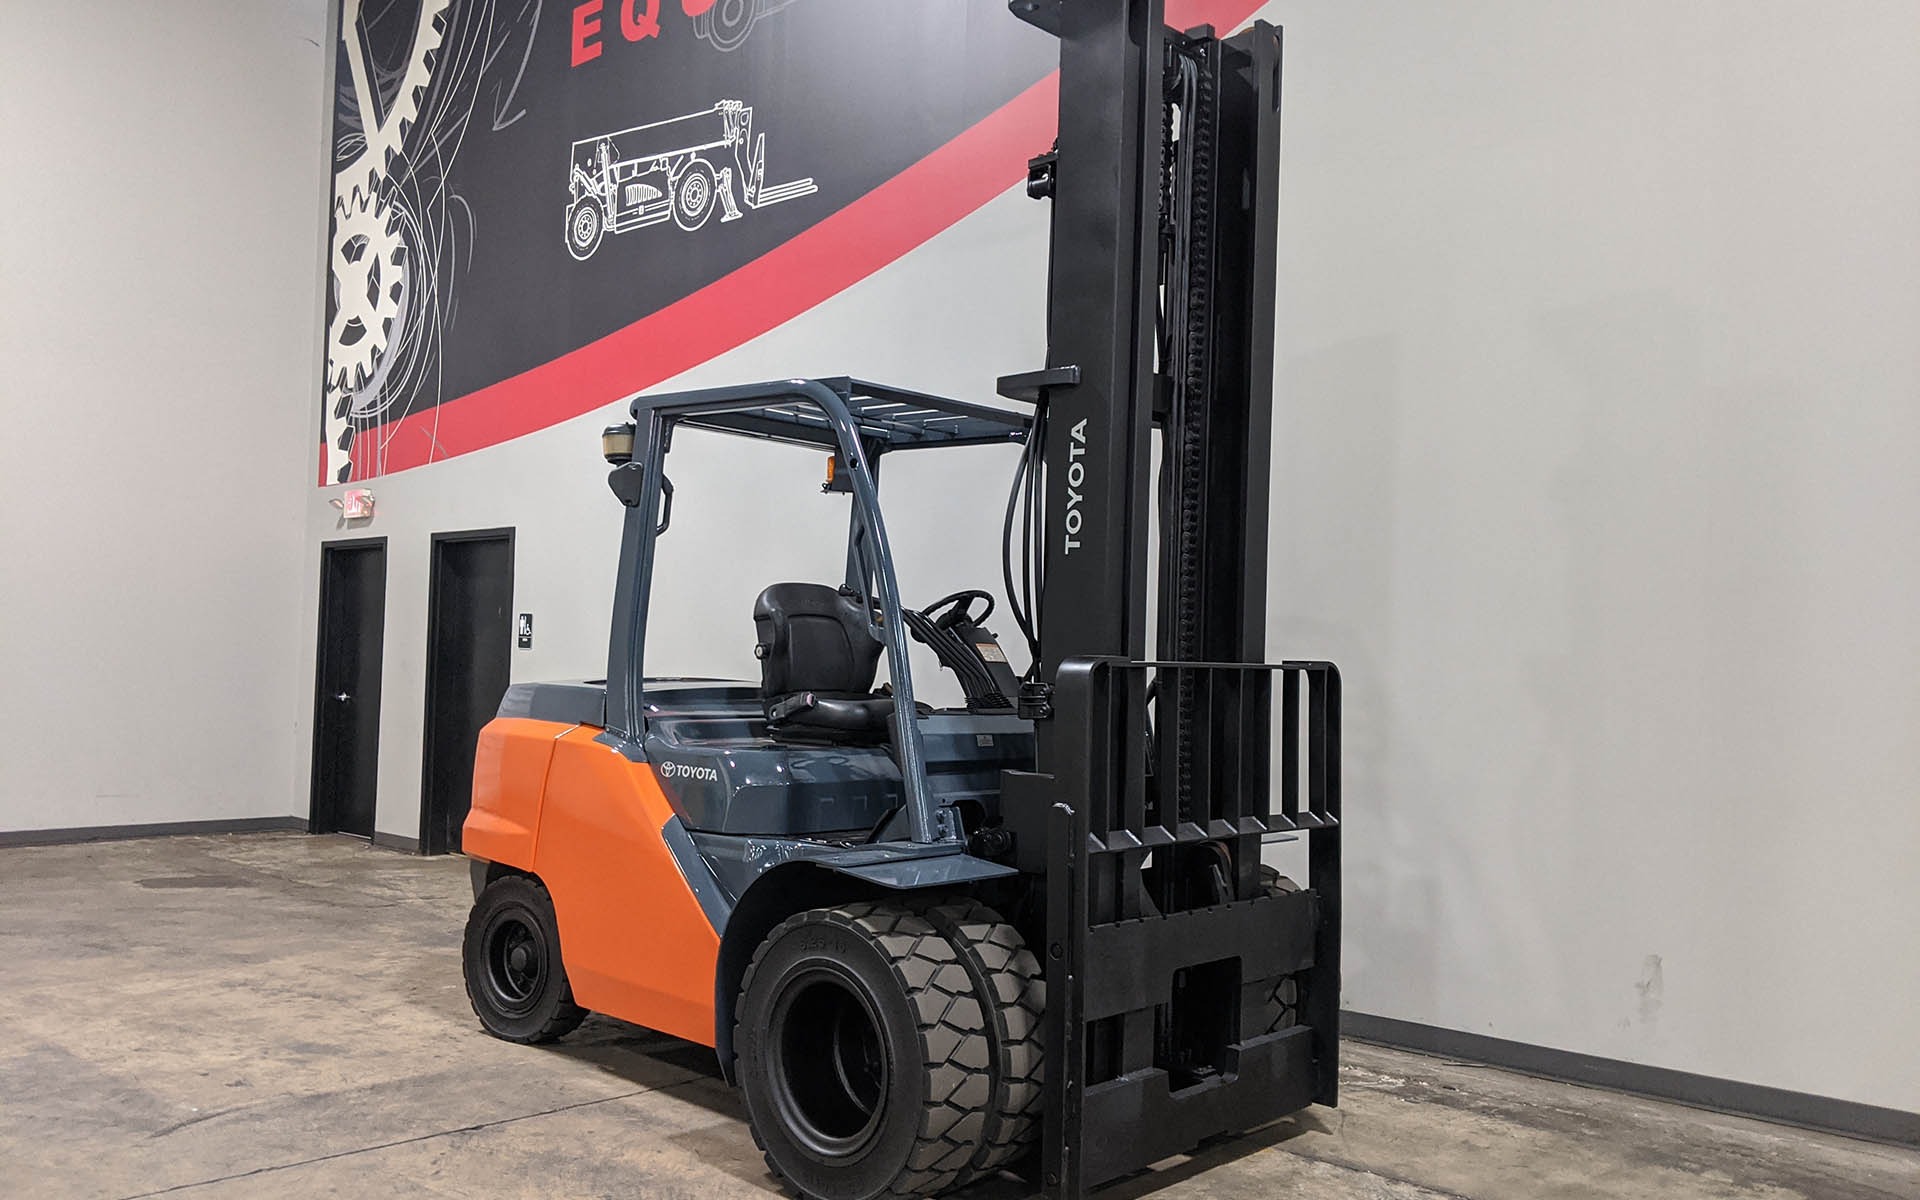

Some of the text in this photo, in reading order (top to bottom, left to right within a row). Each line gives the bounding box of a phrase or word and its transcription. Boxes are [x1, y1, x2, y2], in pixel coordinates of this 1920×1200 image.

[571, 0, 717, 67] EQ
[1064, 418, 1088, 555] TOYOTA
[676, 764, 718, 782] TOYOTA
